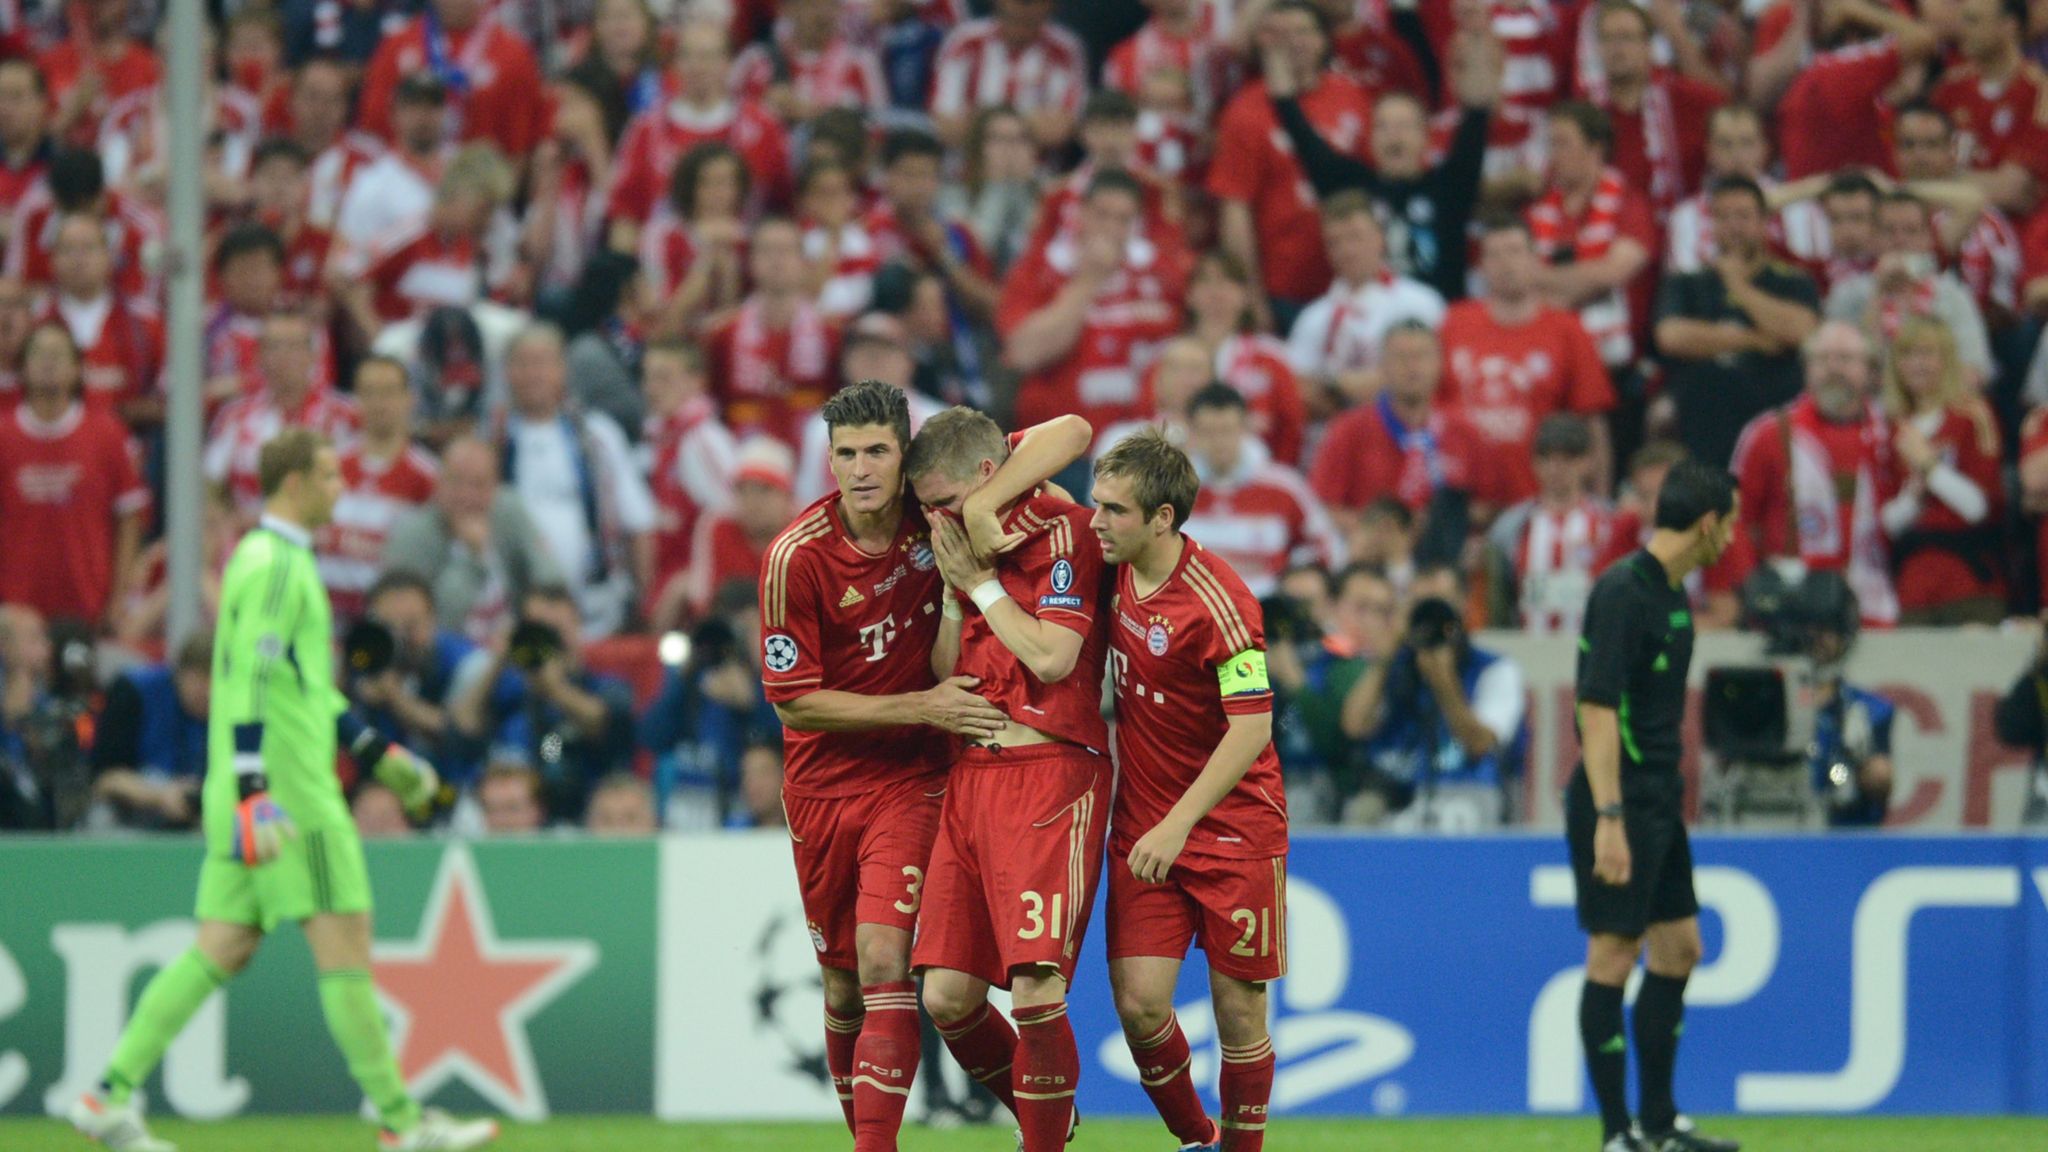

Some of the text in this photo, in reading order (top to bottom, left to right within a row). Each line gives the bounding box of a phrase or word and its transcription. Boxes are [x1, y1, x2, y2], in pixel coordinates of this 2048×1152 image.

[1048, 597, 1081, 606] RESPECT
[1017, 890, 1062, 940] 31
[1230, 907, 1269, 957] 21
[1527, 865, 2048, 1113] PS
[0, 916, 252, 1121] n
[859, 1060, 902, 1078] FCB
